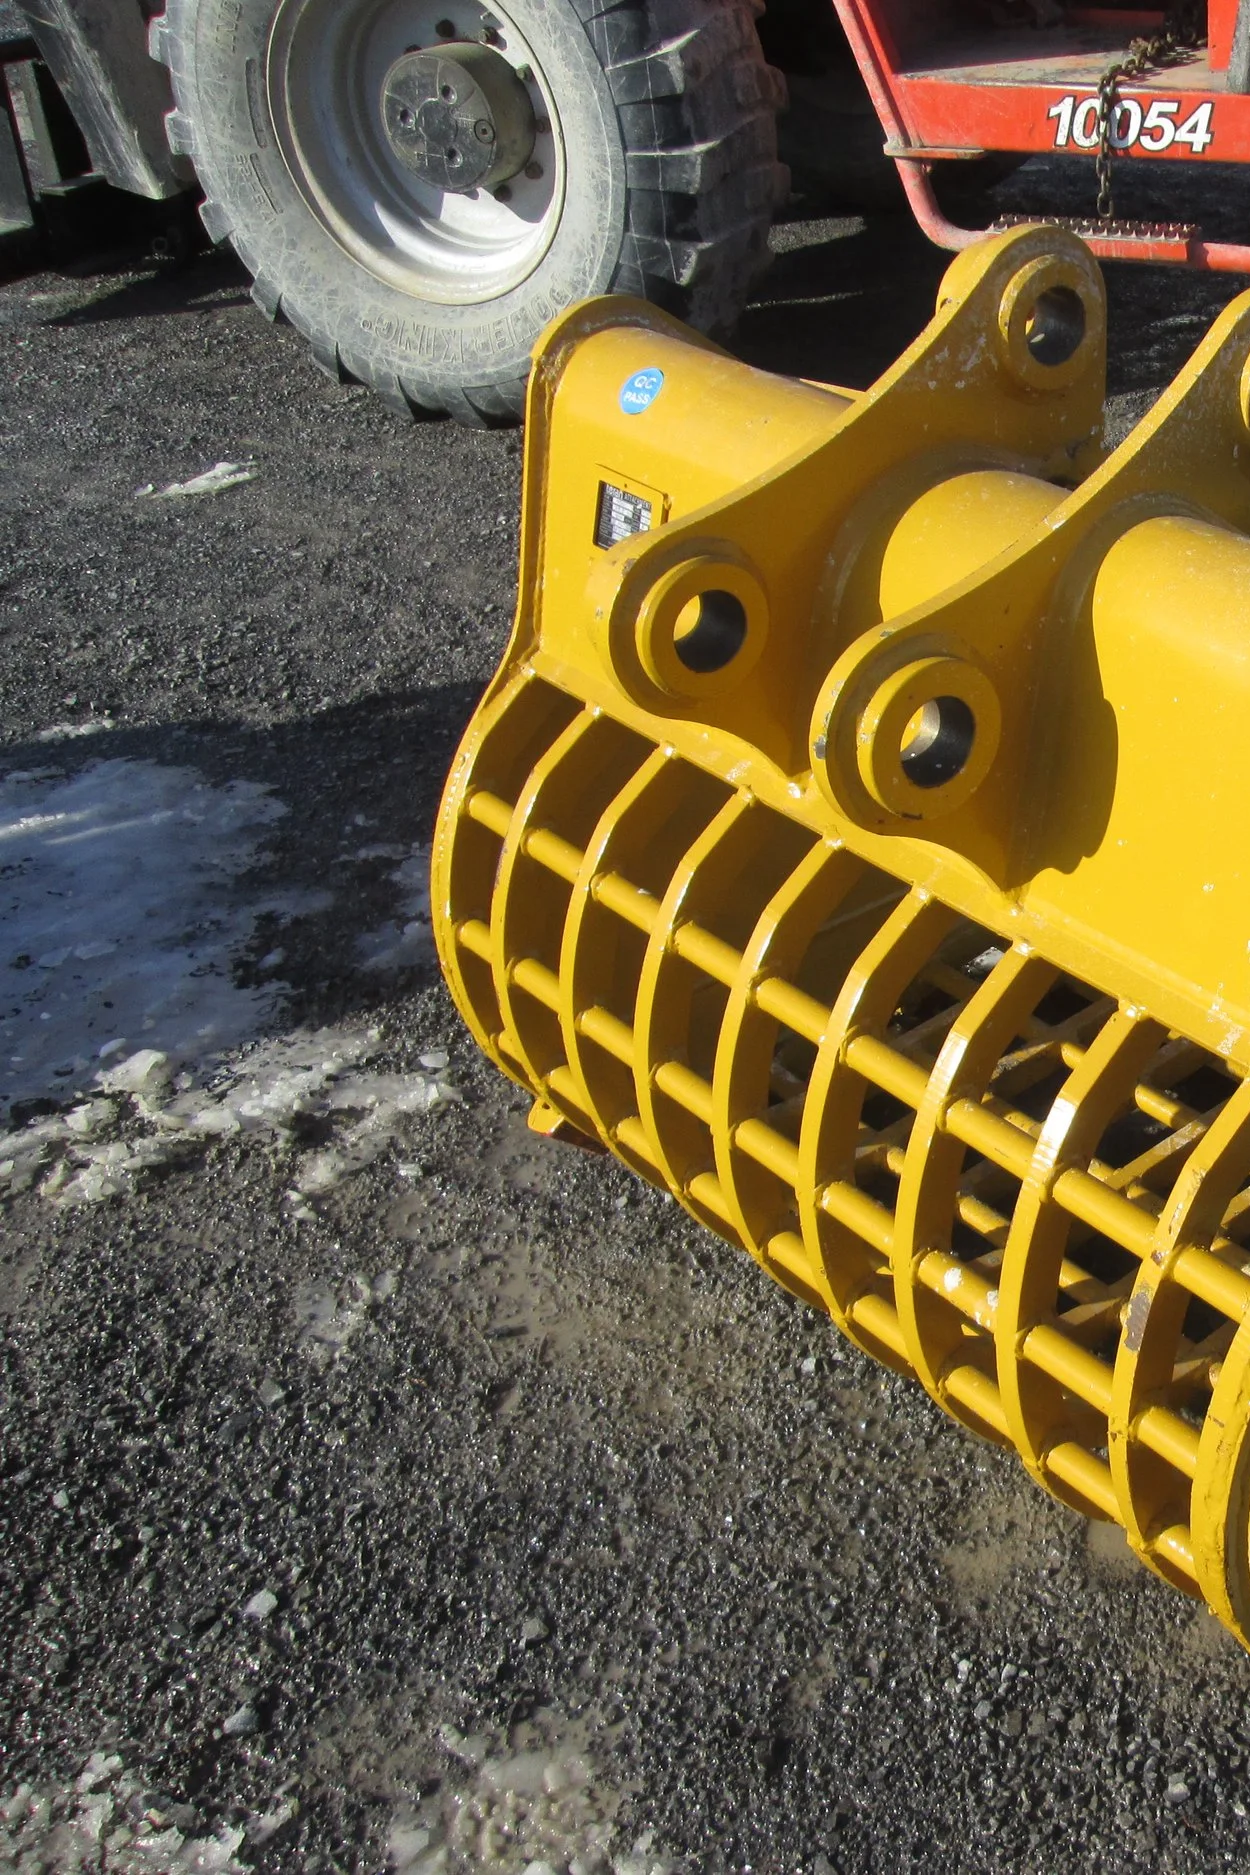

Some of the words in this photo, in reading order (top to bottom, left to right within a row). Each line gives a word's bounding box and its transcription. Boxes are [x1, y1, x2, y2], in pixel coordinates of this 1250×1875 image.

[1047, 95, 1215, 153] 10054
[472, 271, 573, 357] POWER
[623, 391, 649, 405] PASS
[634, 375, 657, 389] QC
